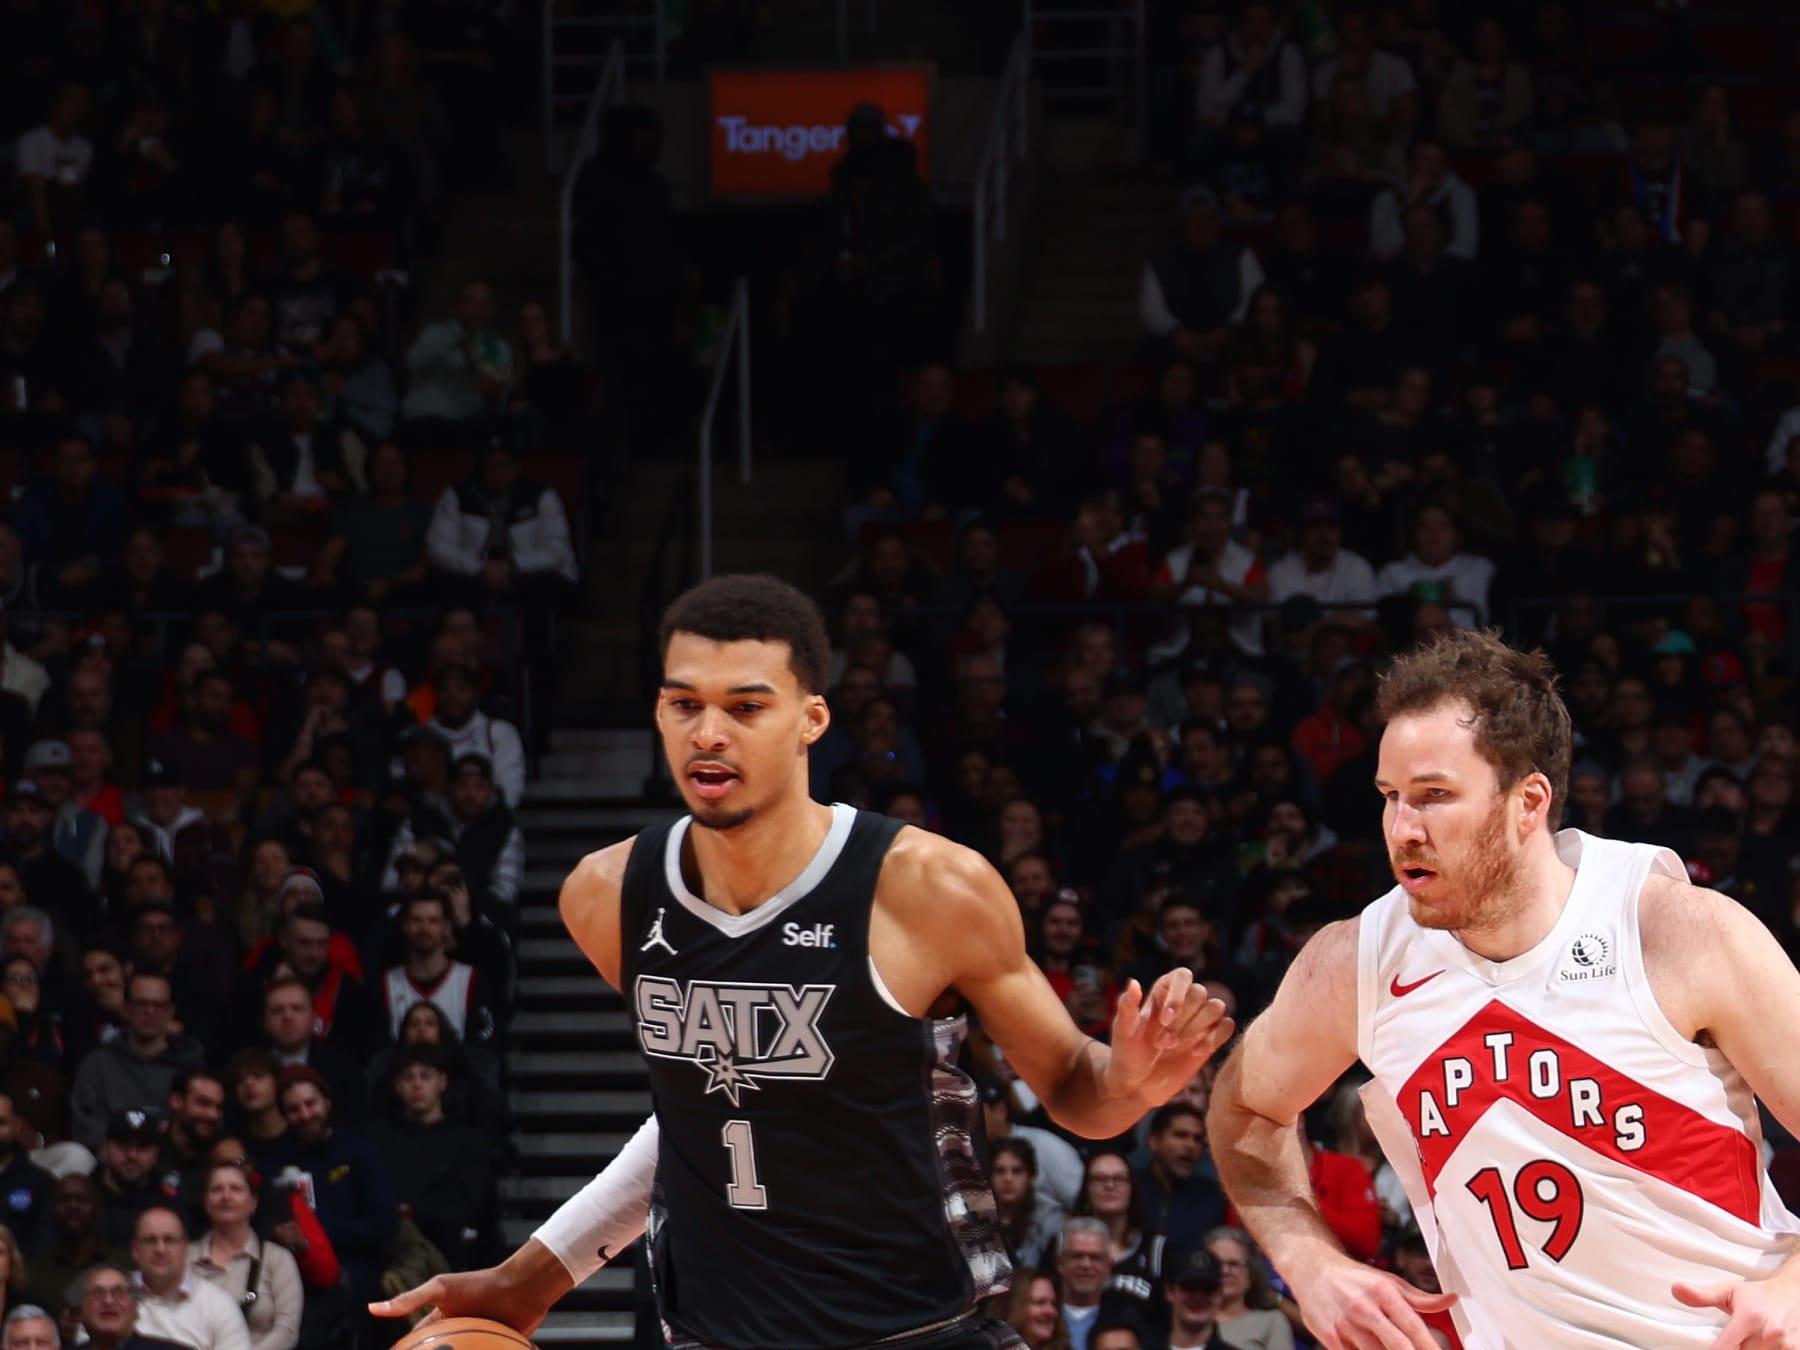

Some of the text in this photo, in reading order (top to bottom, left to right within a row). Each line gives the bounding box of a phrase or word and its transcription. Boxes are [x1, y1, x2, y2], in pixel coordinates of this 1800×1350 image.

[717, 114, 900, 162] Tanger
[1560, 964, 1617, 982] Sun Life
[634, 974, 837, 1081] SATX
[1416, 1030, 1648, 1153] APTORS
[722, 1119, 768, 1210] 1
[1465, 1159, 1585, 1271] 19
